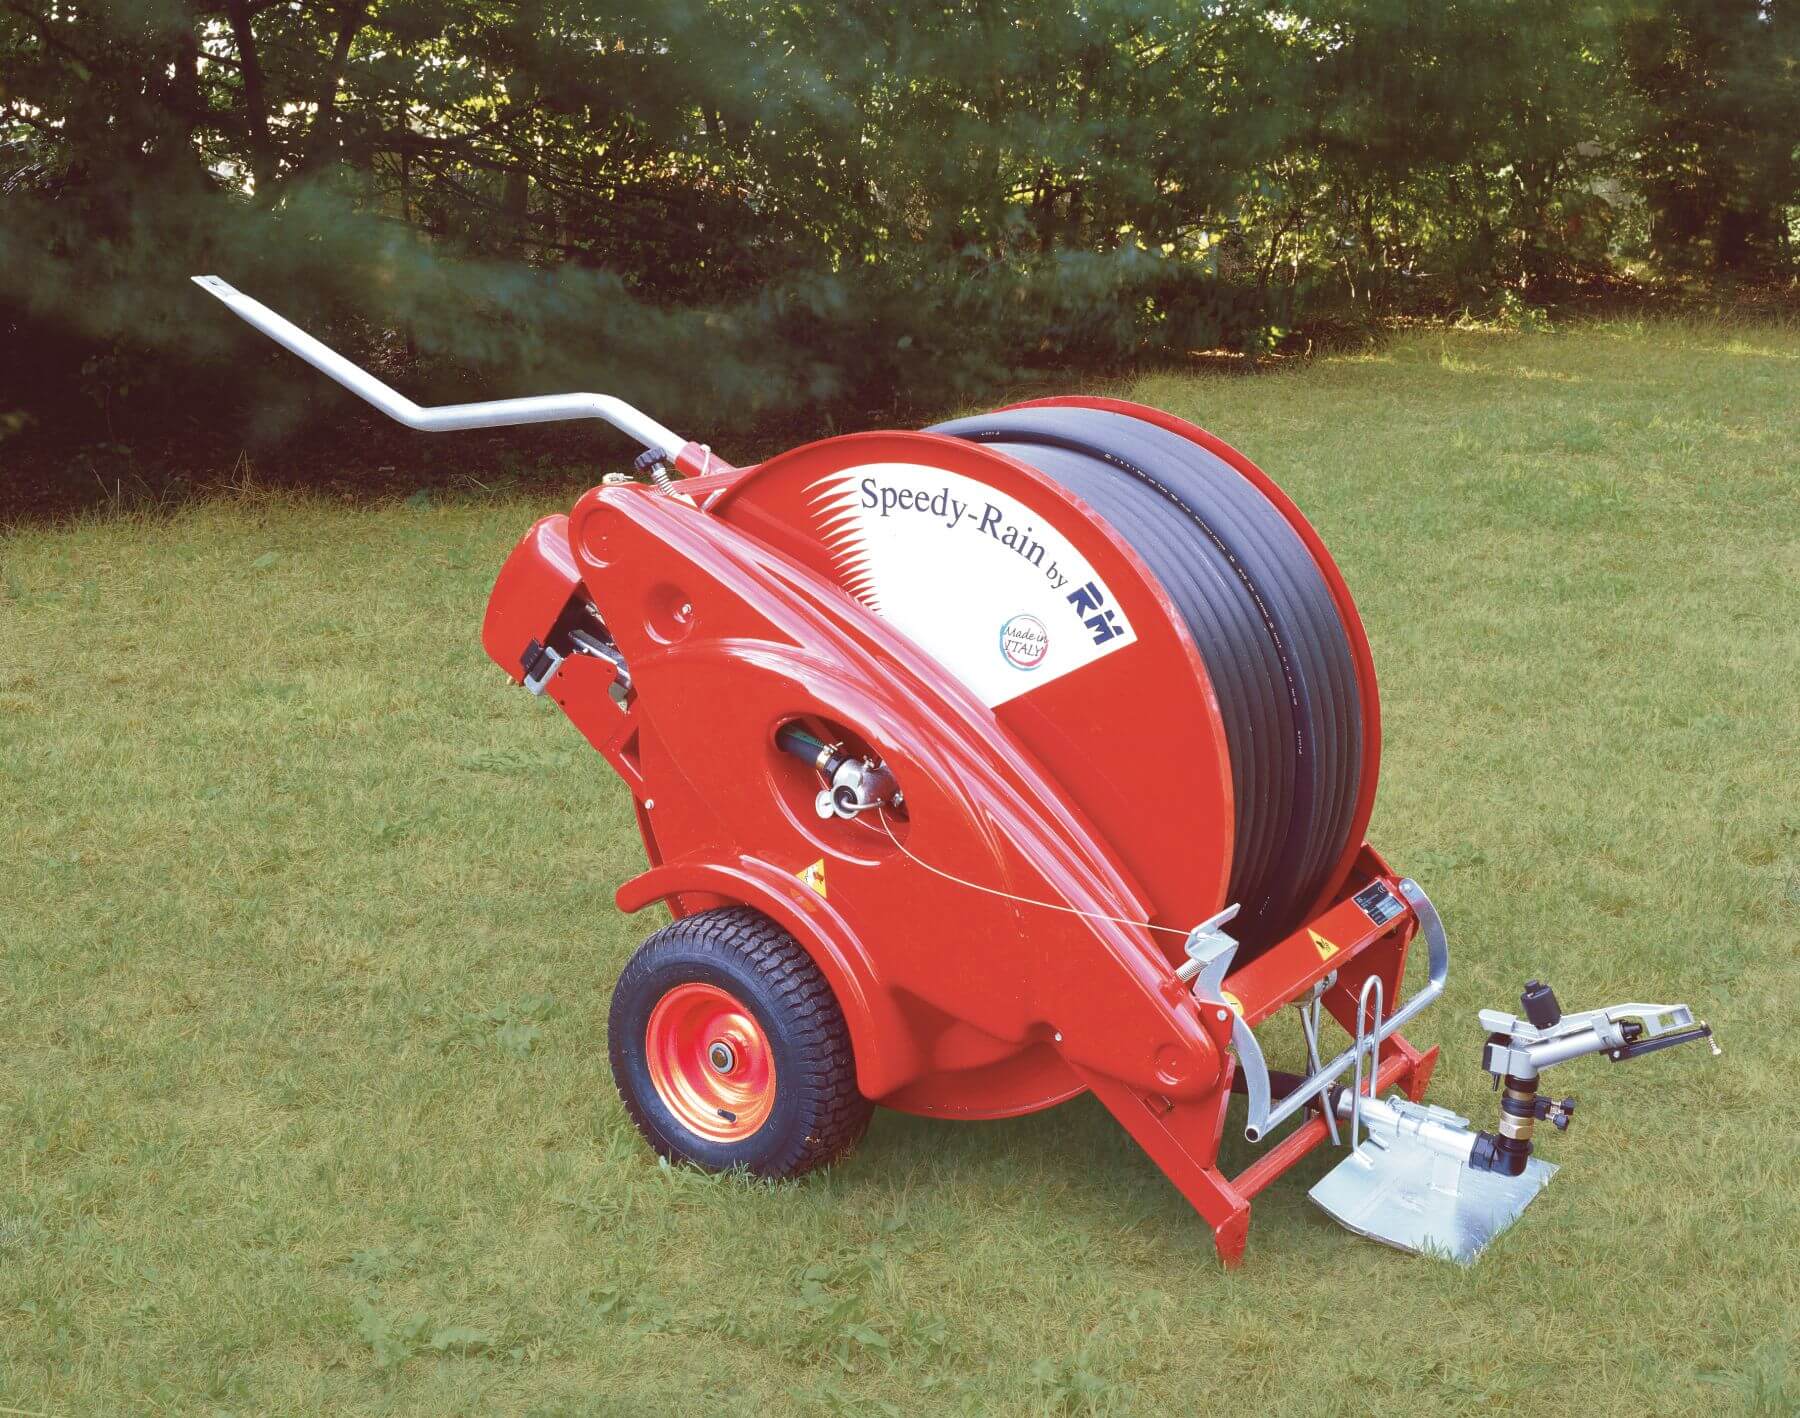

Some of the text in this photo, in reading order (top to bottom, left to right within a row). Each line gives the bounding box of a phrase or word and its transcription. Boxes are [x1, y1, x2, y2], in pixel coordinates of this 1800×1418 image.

[861, 477, 1046, 568] Speedy-Rain
[1046, 561, 1068, 589] by
[1066, 581, 1125, 646] RM
[1004, 626, 1035, 641] Made
[1004, 639, 1044, 657] ITALY
